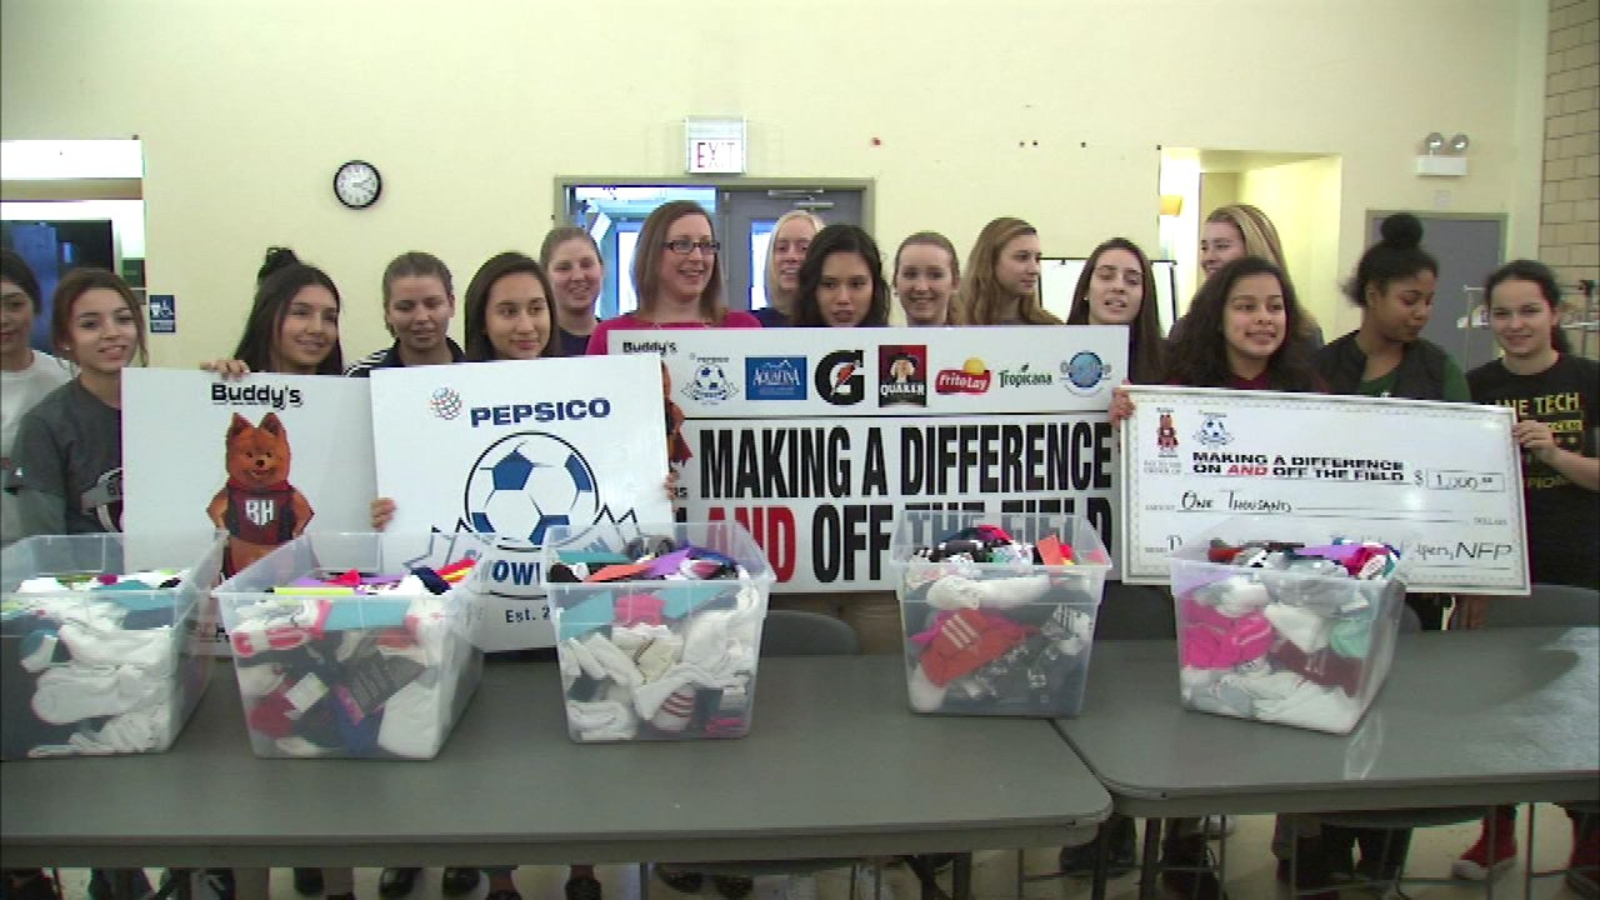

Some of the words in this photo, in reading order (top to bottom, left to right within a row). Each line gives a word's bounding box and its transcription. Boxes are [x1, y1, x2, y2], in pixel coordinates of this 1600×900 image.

[697, 142, 735, 168] EXIT
[622, 341, 677, 354] Buddy's
[814, 349, 865, 405] G
[998, 368, 1053, 388] Tropicana
[211, 383, 302, 409] Buddy's
[880, 383, 925, 396] QUAKER
[470, 397, 611, 427] PEPSICO
[1534, 392, 1580, 415] TECH
[699, 426, 851, 499] MAKING
[862, 426, 888, 497] A
[900, 422, 1112, 498] DIFFERENCE
[1193, 452, 1268, 463] MAKING
[1273, 455, 1286, 465] A
[1291, 457, 1404, 470] DIFFERENCE
[1193, 464, 1221, 473] ON
[1227, 465, 1268, 475] AND
[1273, 467, 1308, 476] OFF
[1315, 469, 1348, 478] THE
[1354, 470, 1404, 480] FIELD
[245, 500, 275, 526] BH
[705, 505, 796, 583] AND
[811, 504, 893, 583] OFF
[1455, 542, 1513, 561] NFP
[505, 608, 536, 623] Est.
